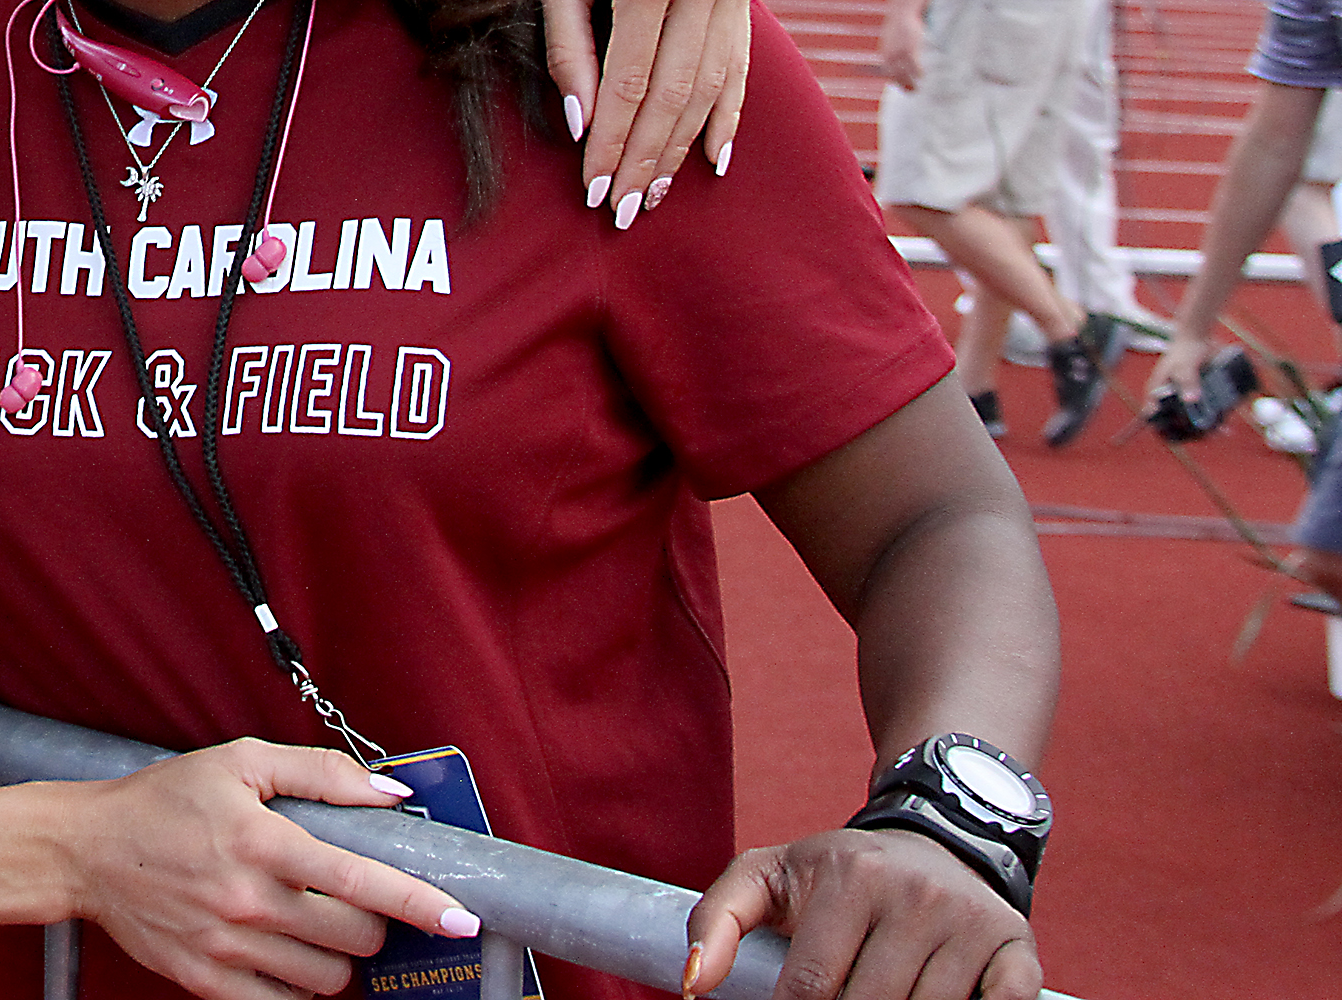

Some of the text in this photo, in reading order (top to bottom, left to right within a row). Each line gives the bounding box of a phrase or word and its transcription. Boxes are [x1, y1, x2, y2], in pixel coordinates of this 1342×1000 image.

[127, 218, 451, 299] CAROLINA
[137, 350, 197, 439] &
[222, 344, 451, 441] FIELD
[371, 963, 481, 992] SEC CHAMPIONS
